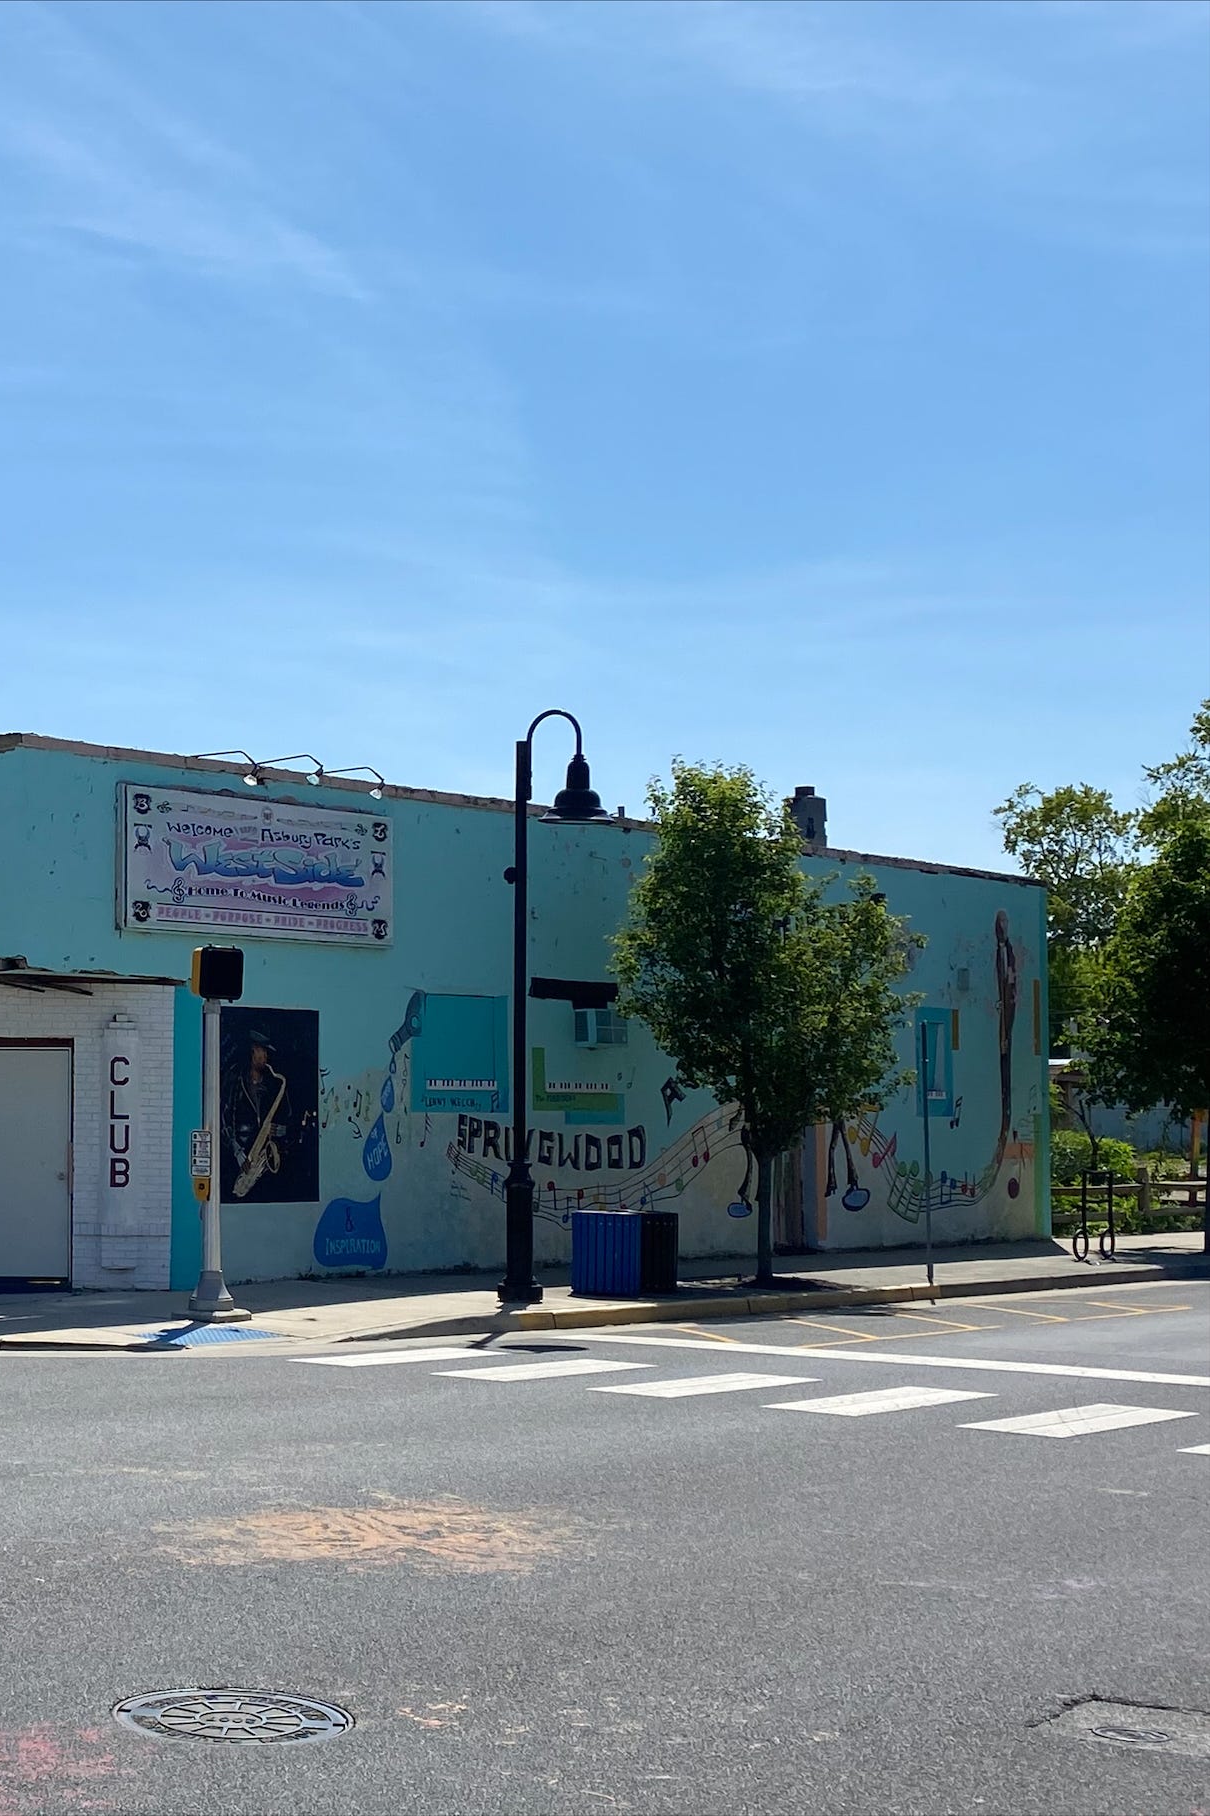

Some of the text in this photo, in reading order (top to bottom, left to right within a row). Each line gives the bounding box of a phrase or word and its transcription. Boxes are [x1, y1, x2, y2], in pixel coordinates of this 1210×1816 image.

[167, 821, 361, 850] Welcome Asbury Park's
[188, 886, 345, 911] Home To Music Legends
[157, 907, 368, 932] PEOPLE PURPOSE PRIDE PROGRESS
[109, 1056, 130, 1188] CLUB
[367, 1133, 389, 1170] HOPE
[325, 1237, 381, 1256] INSPIRATION
